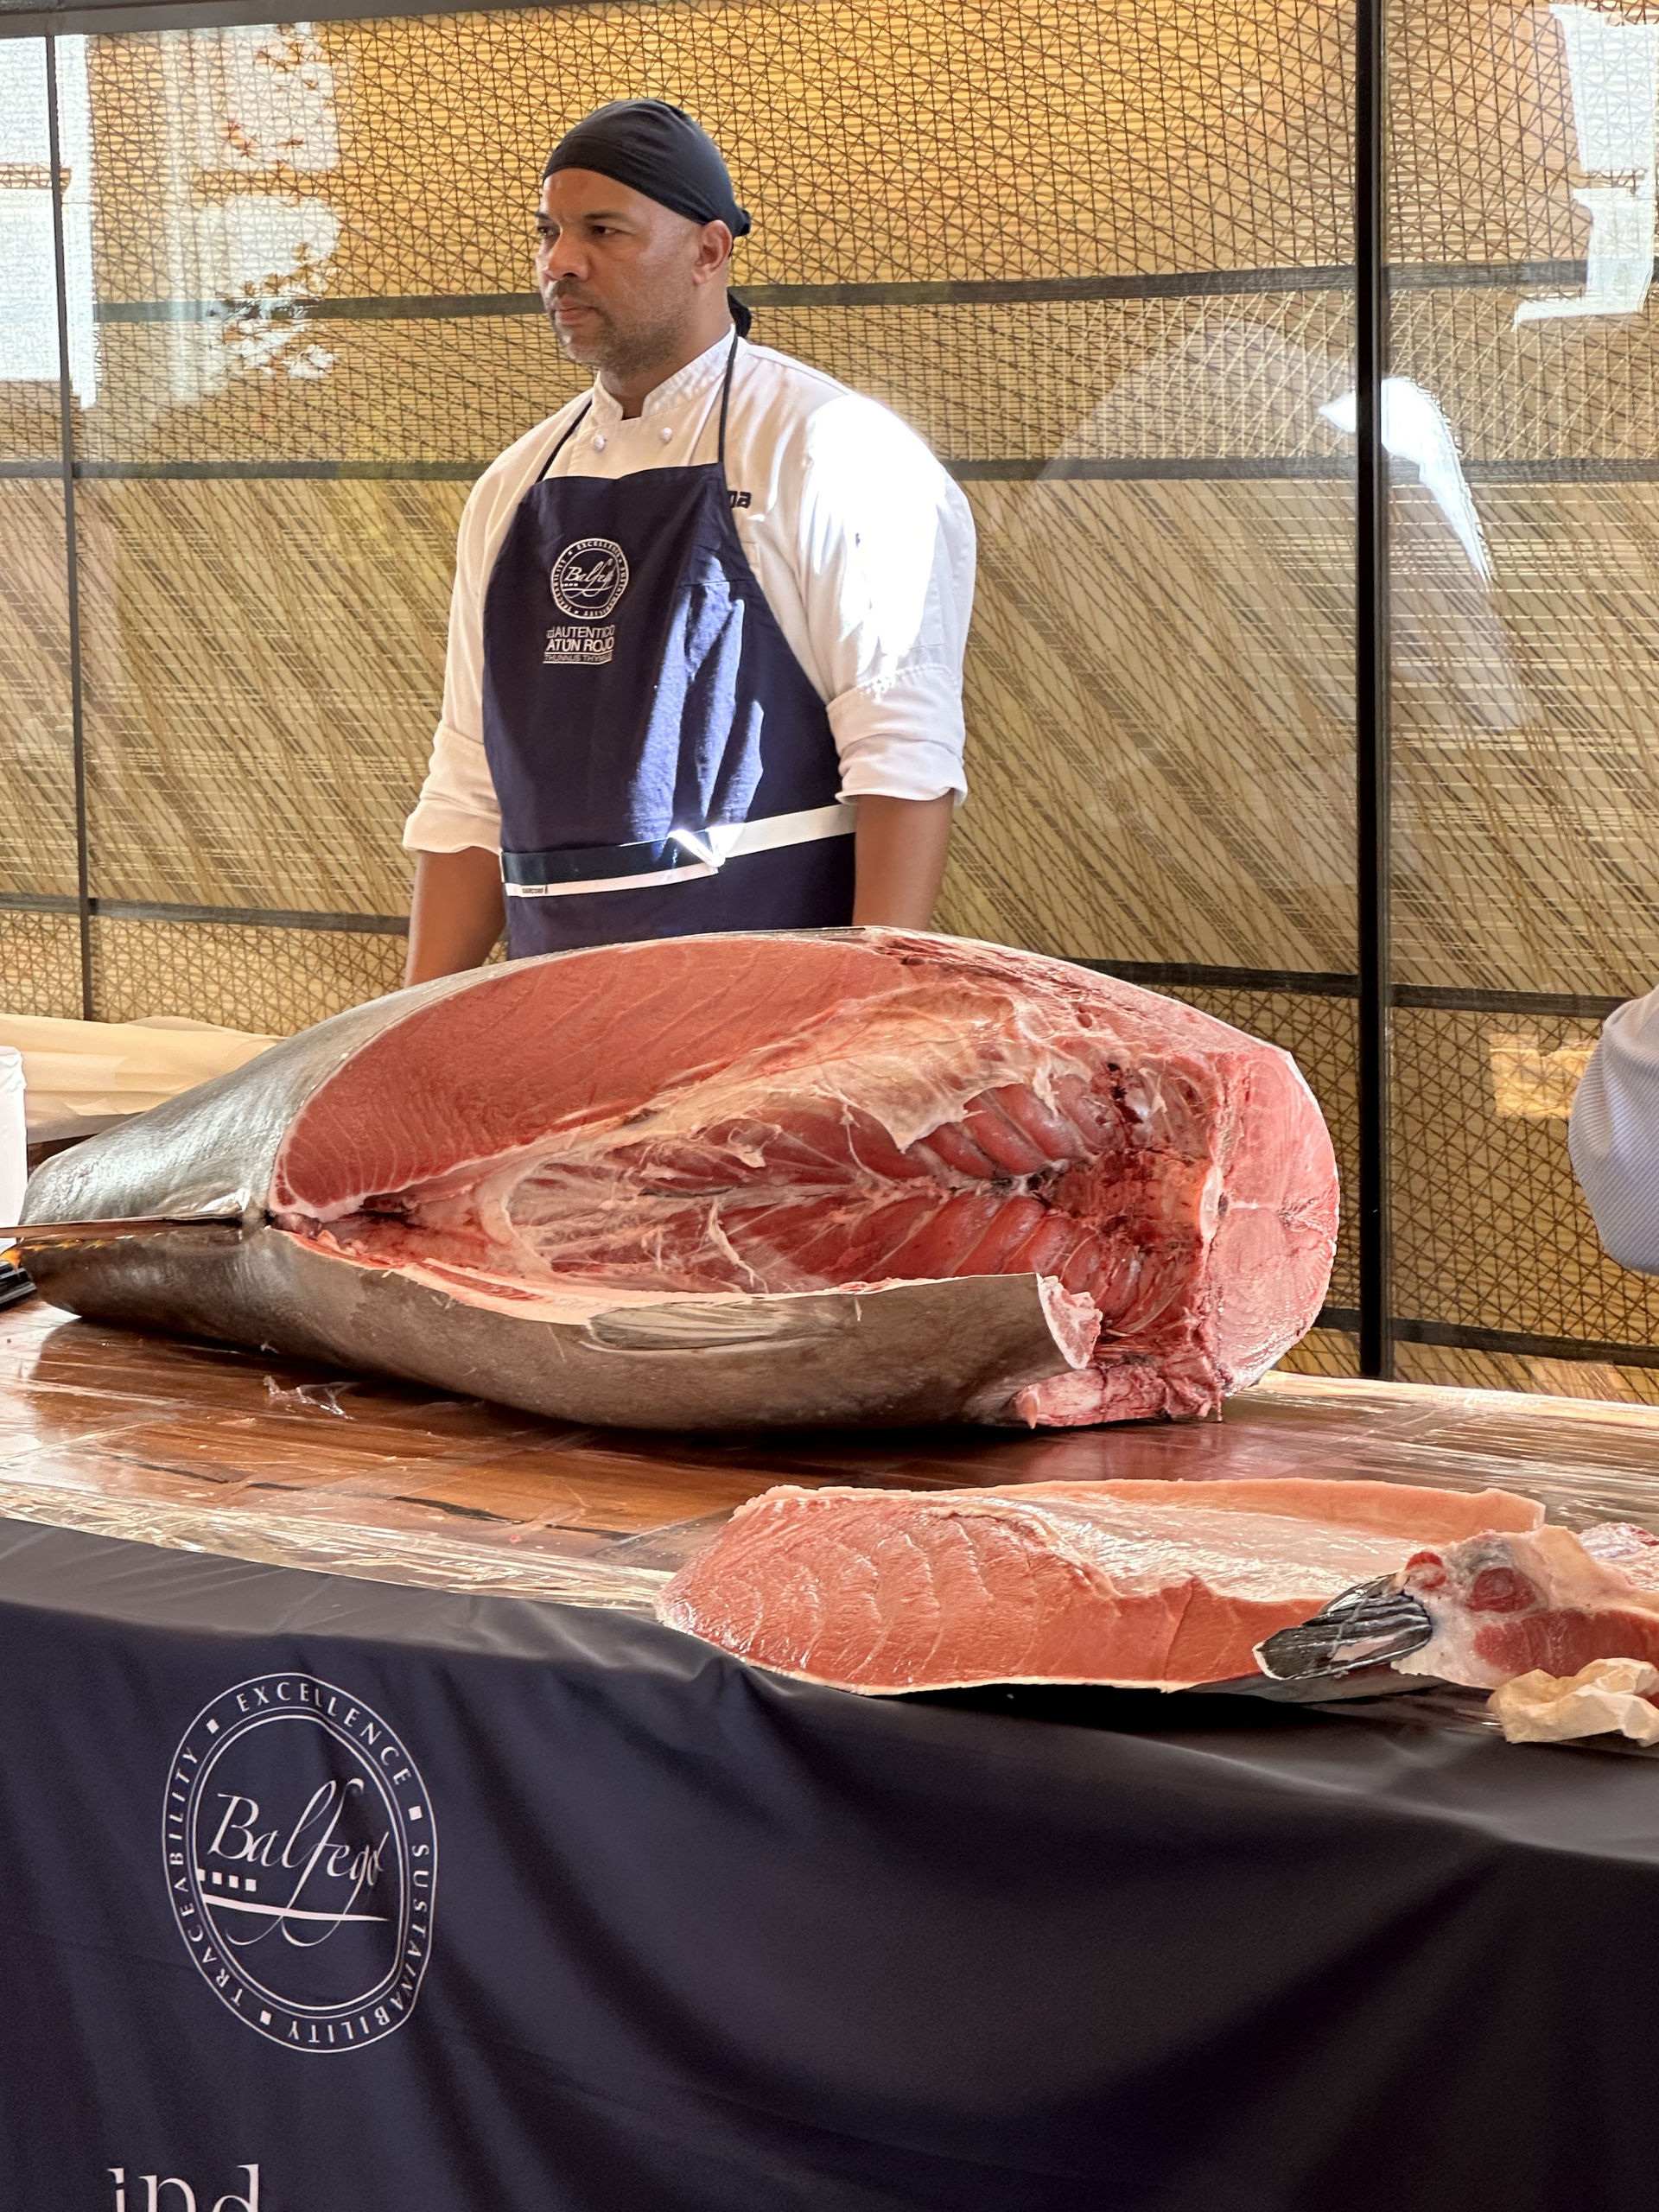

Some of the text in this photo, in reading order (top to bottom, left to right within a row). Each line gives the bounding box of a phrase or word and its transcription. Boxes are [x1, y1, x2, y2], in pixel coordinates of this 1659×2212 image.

[236, 1681, 411, 1786] EXCELLENCE
[168, 1746, 244, 2006] TRACEABILITY
[288, 1844, 429, 2044] SUSTAINABILITY
